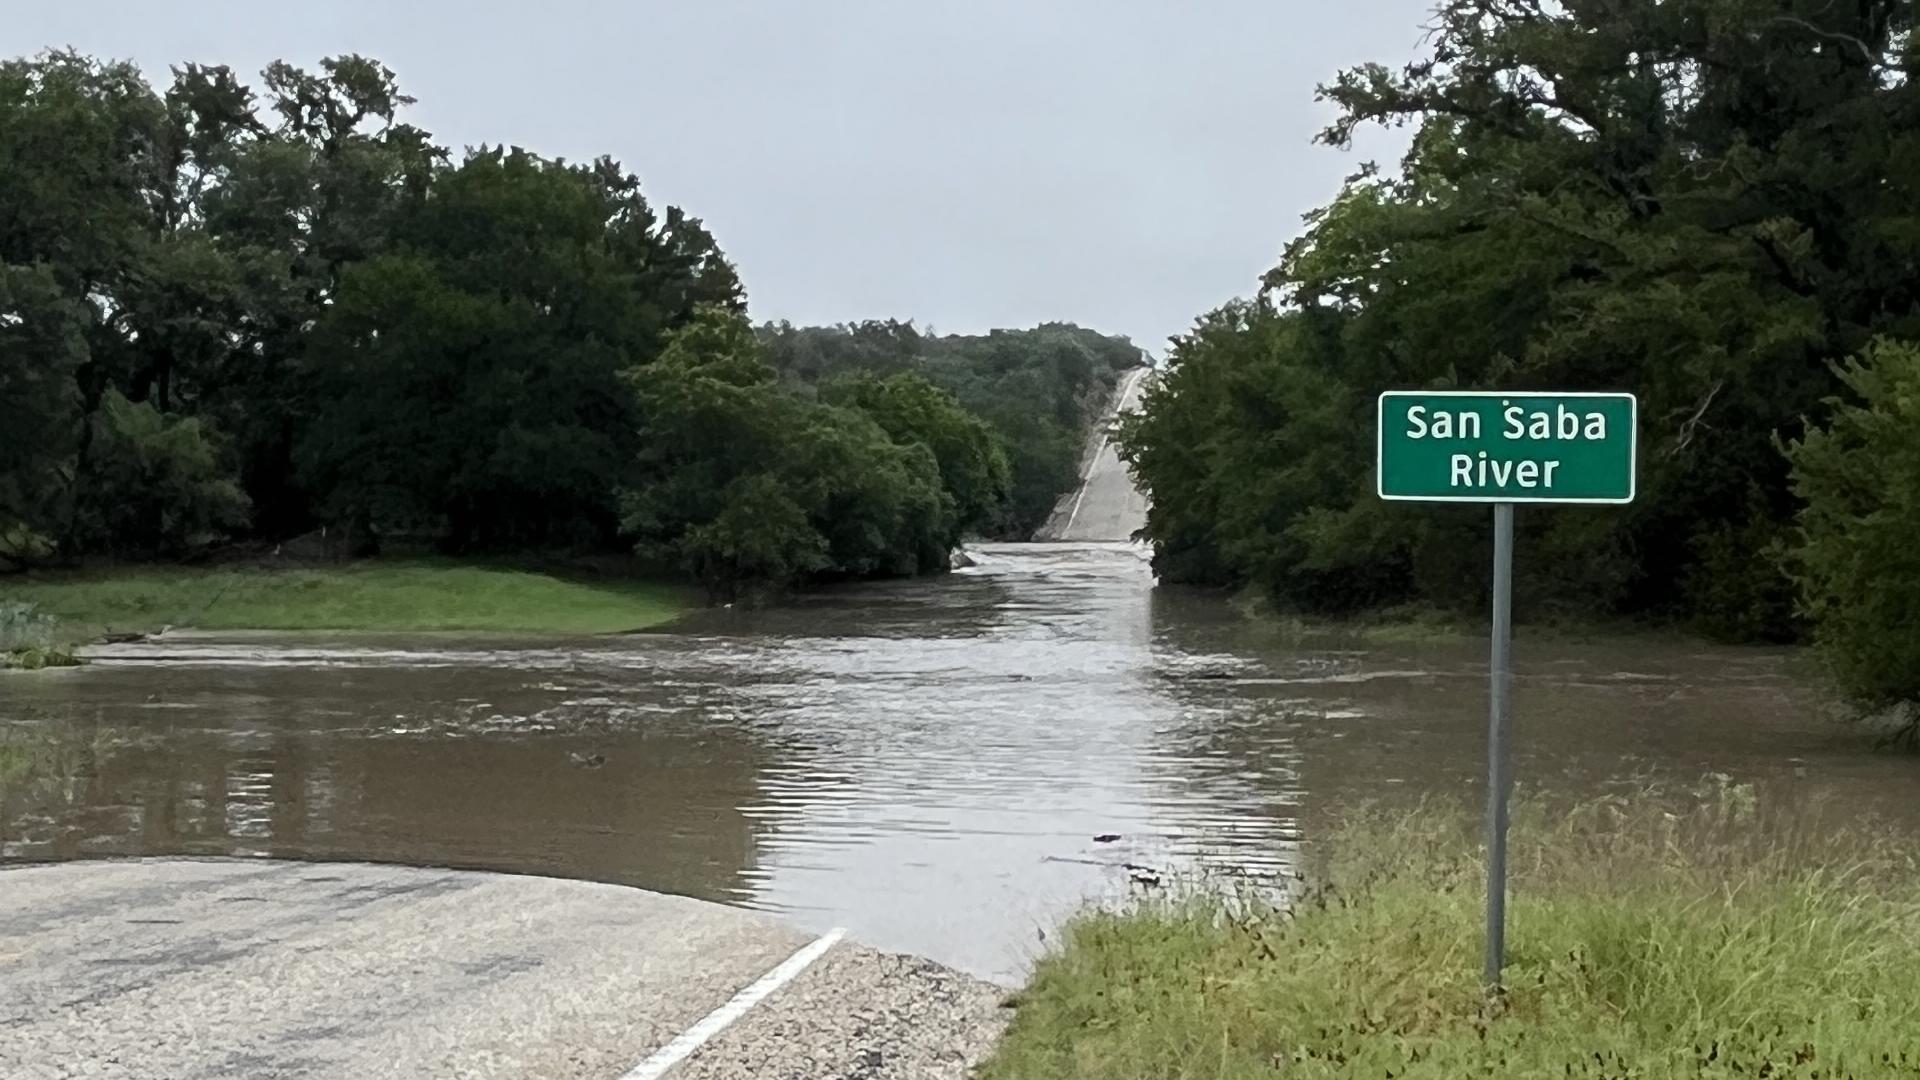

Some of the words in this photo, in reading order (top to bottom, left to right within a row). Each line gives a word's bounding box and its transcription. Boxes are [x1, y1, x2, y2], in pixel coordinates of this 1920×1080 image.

[1406, 405, 1480, 439] San
[1503, 403, 1606, 440] Saba
[1451, 451, 1560, 488] River
